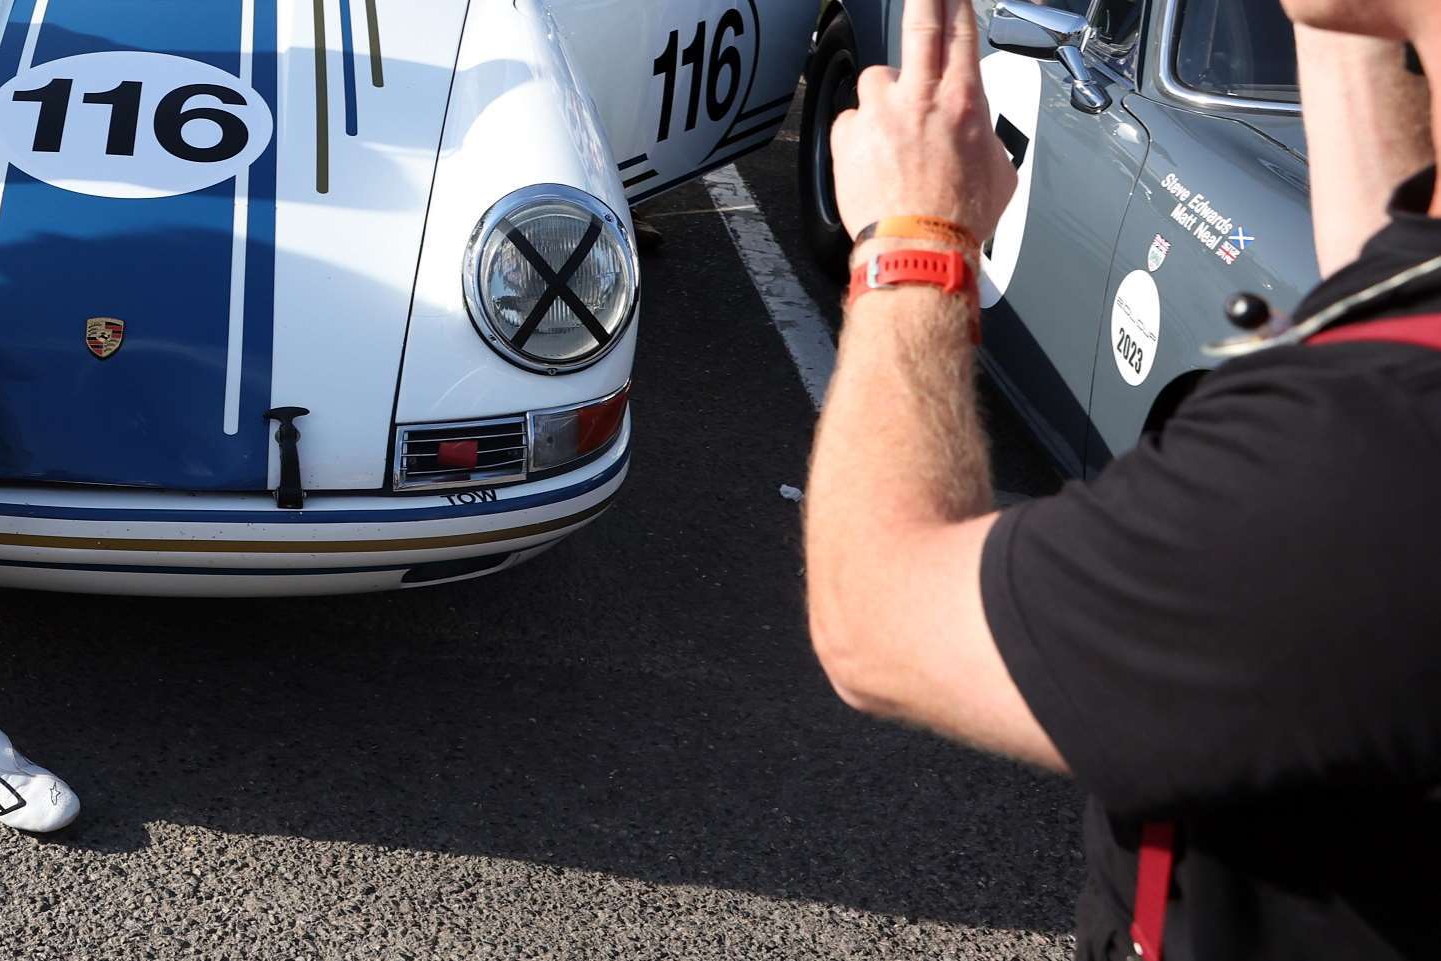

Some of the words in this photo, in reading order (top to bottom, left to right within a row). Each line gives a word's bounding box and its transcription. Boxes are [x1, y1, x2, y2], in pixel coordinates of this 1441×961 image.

[653, 8, 744, 143] 116
[12, 78, 249, 162] 116
[1161, 173, 1191, 202] Steve
[1188, 193, 1233, 234] Edwards
[1170, 202, 1198, 231] Matt
[1193, 221, 1223, 250] Neal
[1116, 327, 1143, 374] 2023
[439, 489, 497, 506] TOW
